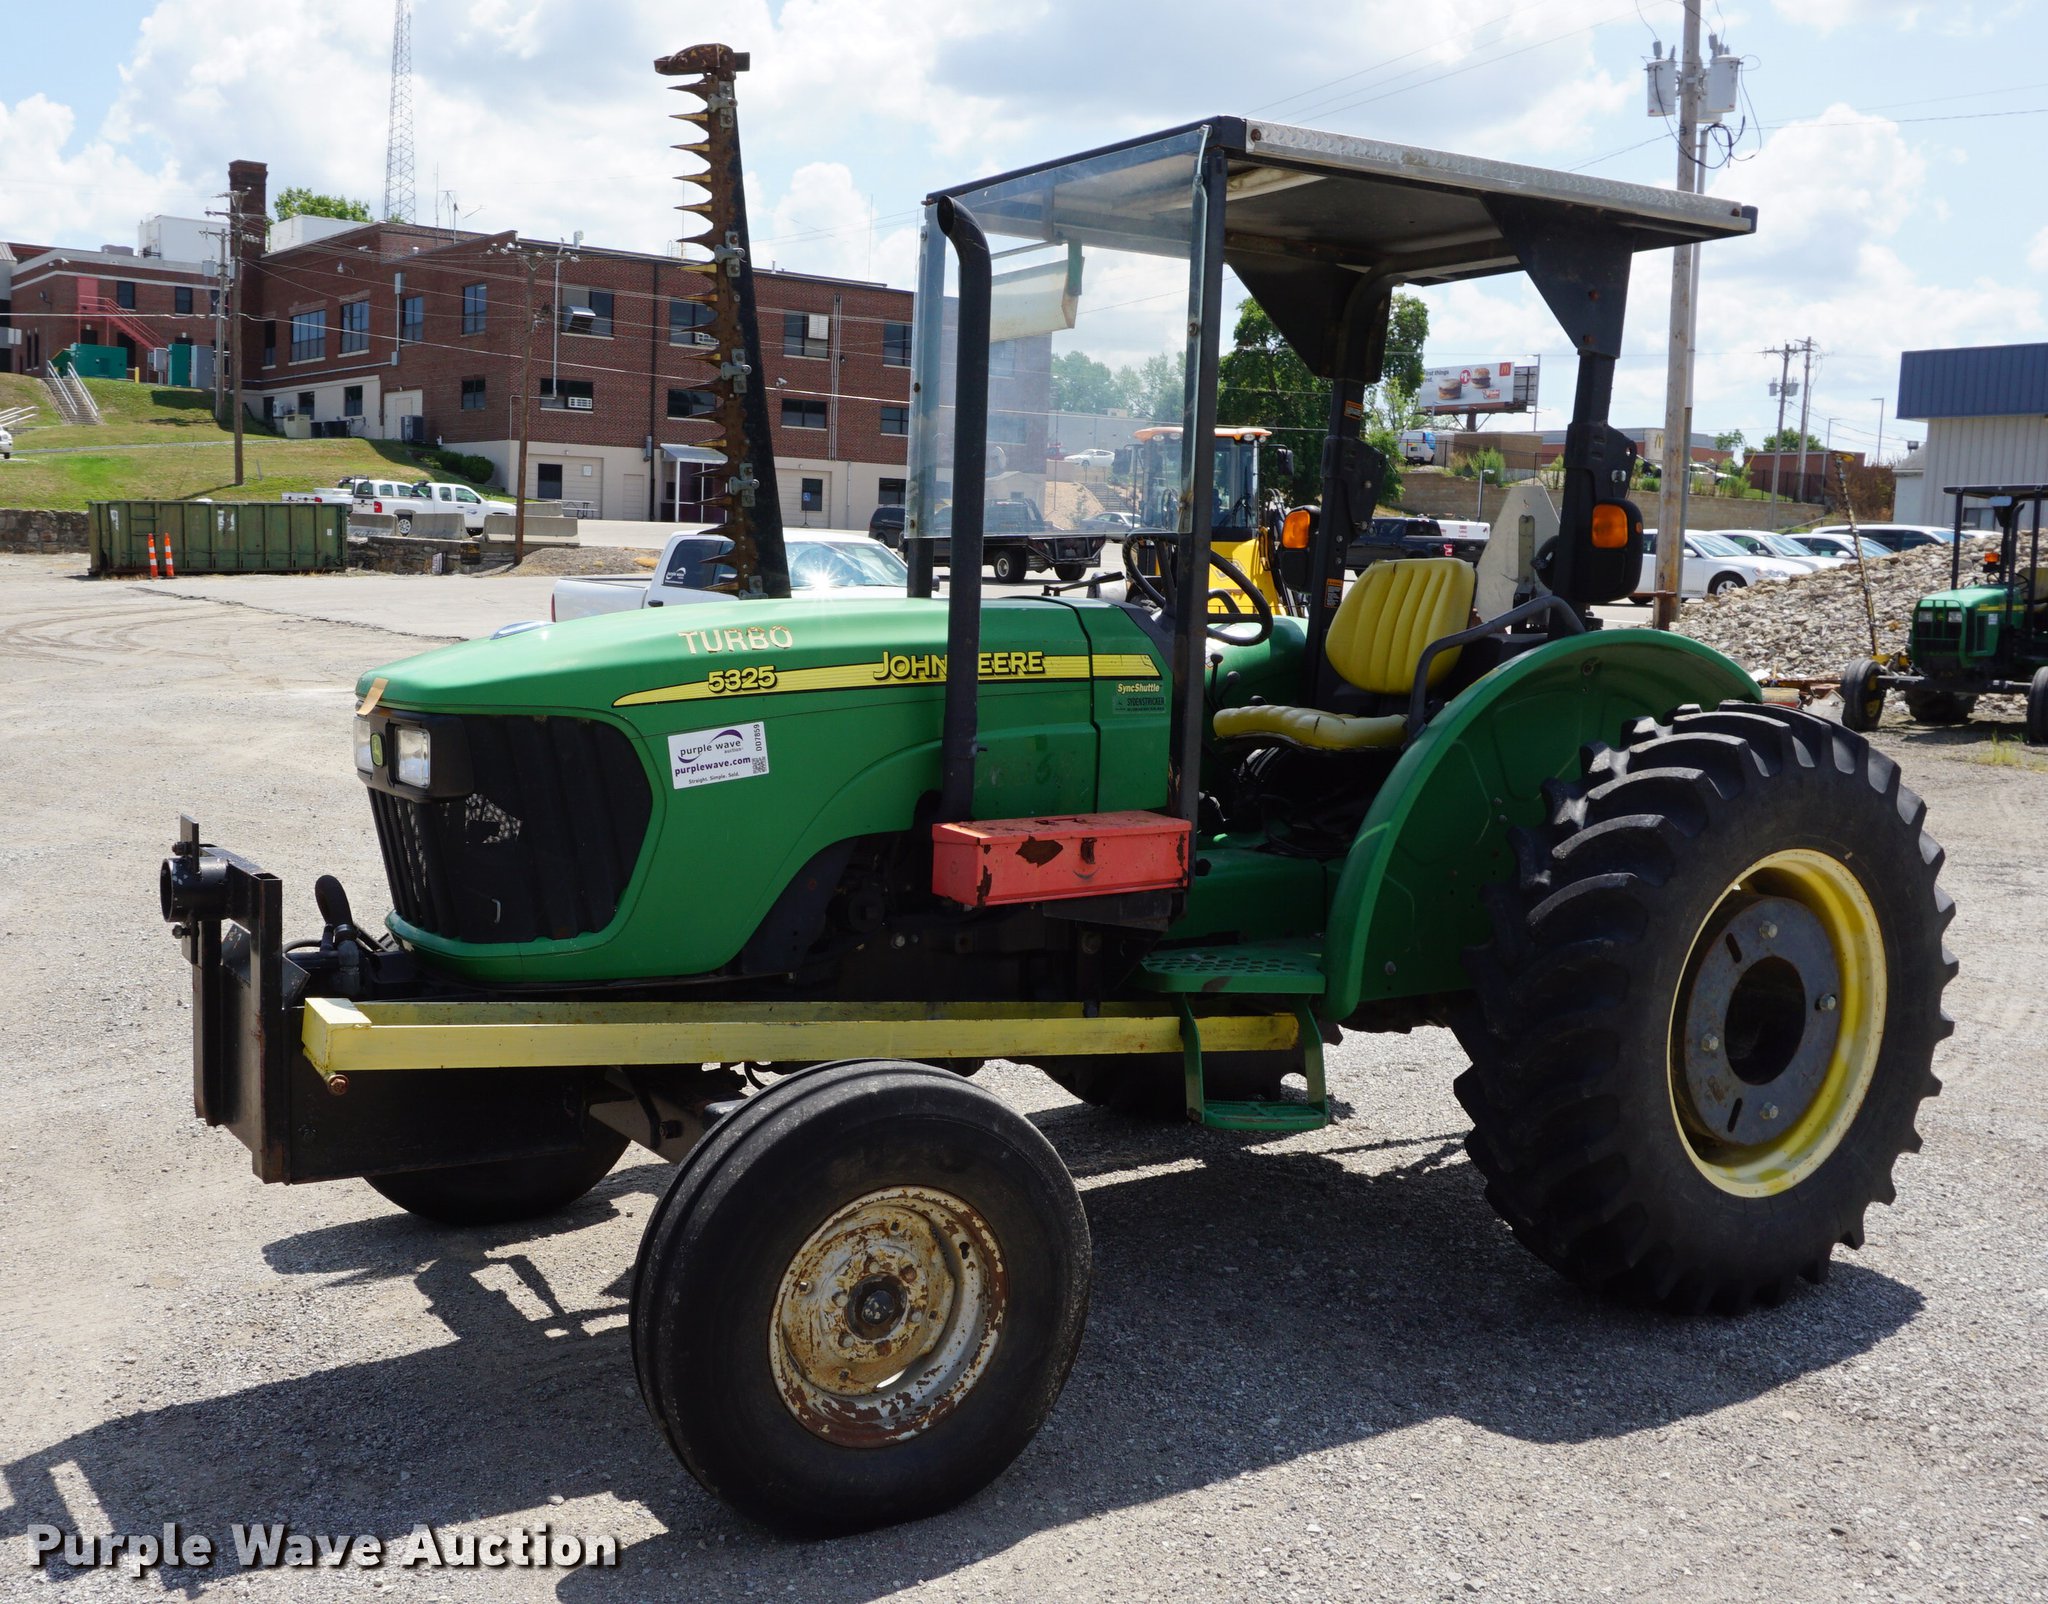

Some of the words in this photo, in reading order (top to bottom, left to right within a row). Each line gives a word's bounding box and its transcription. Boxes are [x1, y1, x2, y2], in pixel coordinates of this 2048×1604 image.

[678, 625, 793, 655] TURBO
[873, 651, 948, 680] JOHN
[977, 651, 1044, 675] EERE
[708, 665, 777, 693] 5325
[1117, 683, 1160, 695] SyncShuttle
[680, 745, 712, 757] purple
[715, 740, 741, 750] wave
[675, 757, 751, 777] purplewave.com
